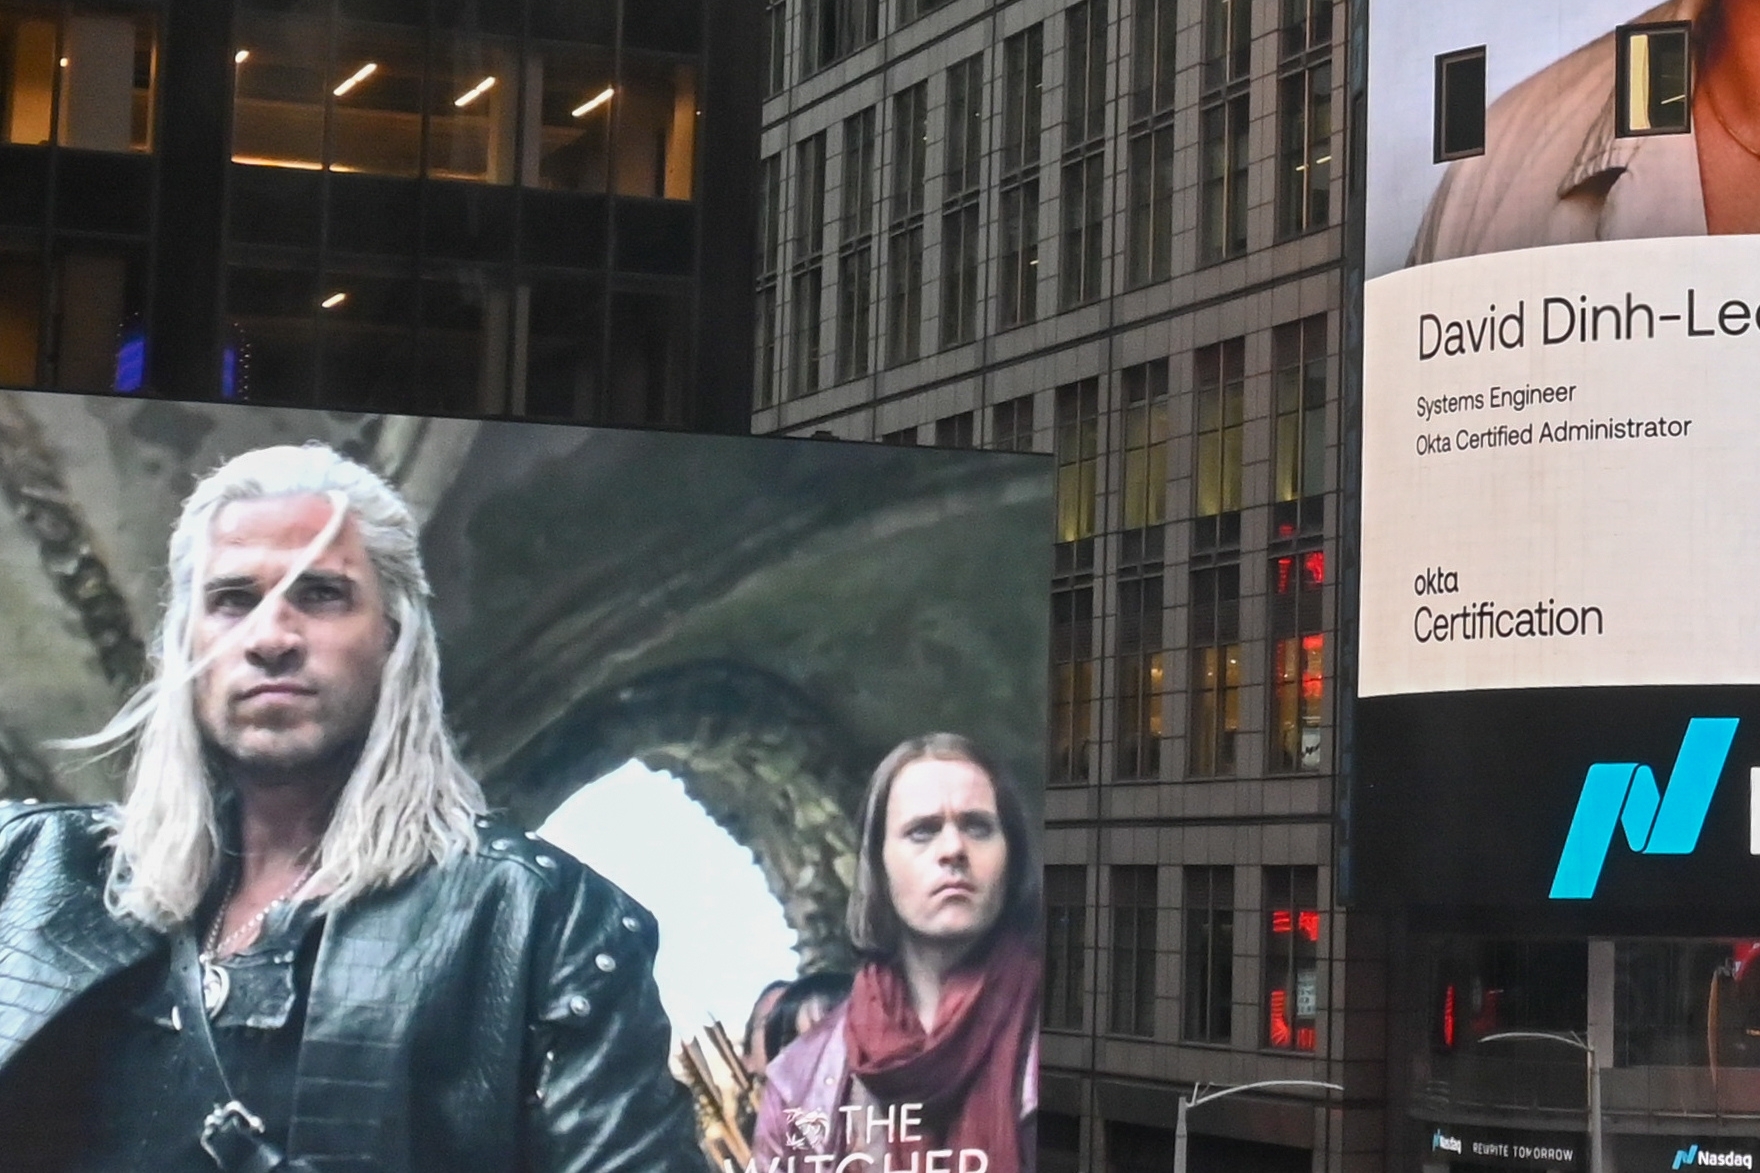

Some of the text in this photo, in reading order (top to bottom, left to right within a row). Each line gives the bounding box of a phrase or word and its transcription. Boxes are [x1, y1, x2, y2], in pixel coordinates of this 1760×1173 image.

[1419, 300, 1525, 361] David
[1416, 383, 1577, 420] Systems Engineer
[1416, 417, 1692, 456] Okta Certified Administrator
[1414, 566, 1459, 596] okta
[1414, 598, 1604, 643] Certification
[838, 1102, 923, 1145] THE
[1513, 1145, 1575, 1162] TOMORROW
[1697, 1150, 1753, 1170] Nasdaq
